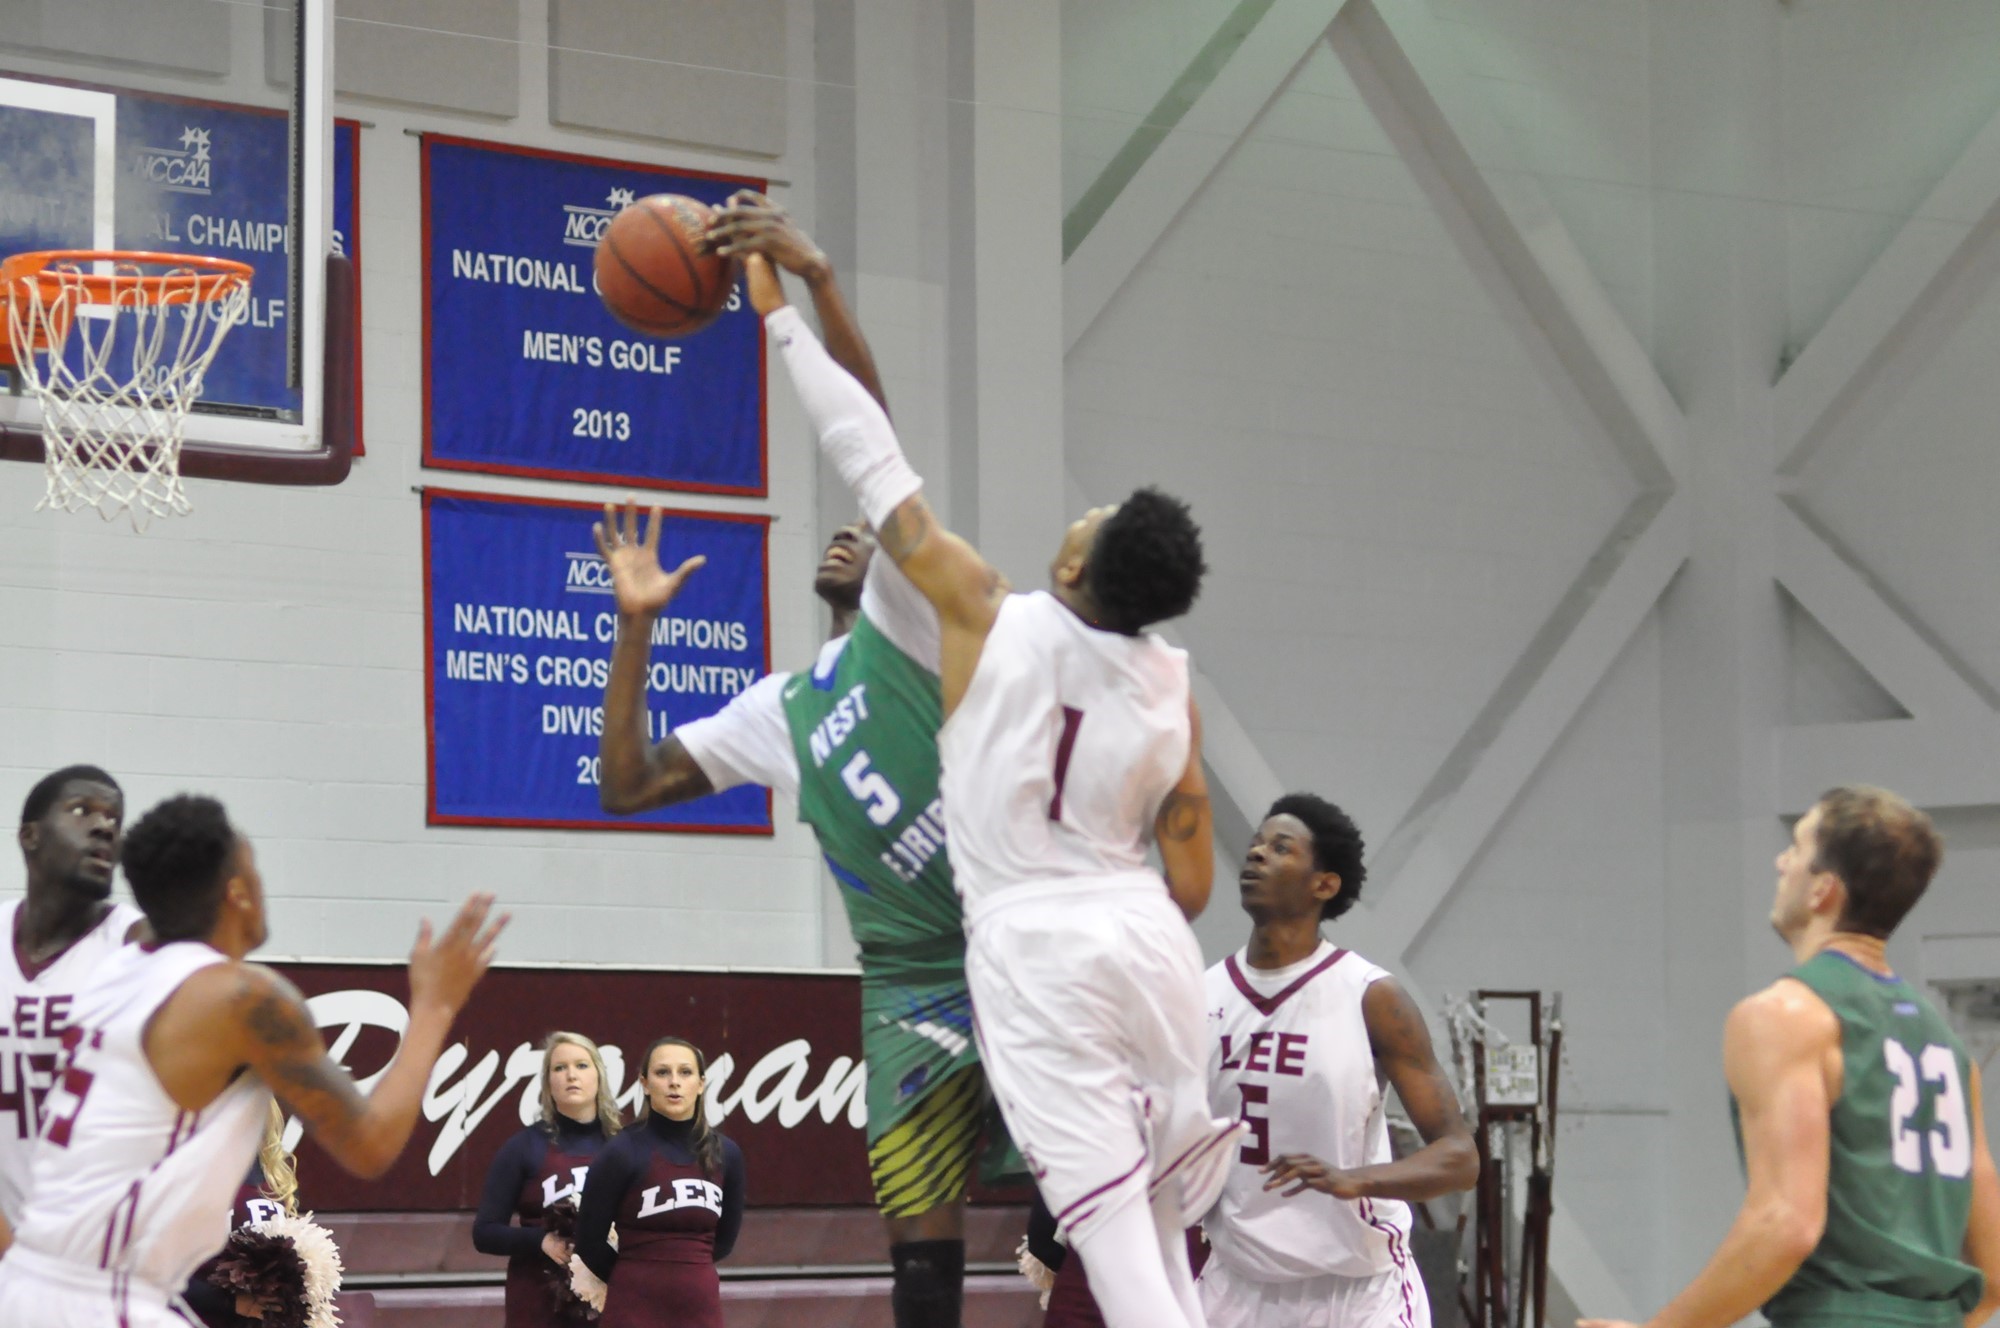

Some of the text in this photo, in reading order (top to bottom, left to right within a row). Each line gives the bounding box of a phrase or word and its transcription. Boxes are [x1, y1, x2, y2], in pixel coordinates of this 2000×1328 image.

[133, 156, 210, 188] NCCAA
[565, 212, 612, 241] NCC
[452, 249, 585, 293] NATIONAL
[523, 330, 681, 374] MEN'S GOLF
[573, 408, 631, 441] 2013
[566, 559, 614, 588] NCC
[454, 603, 589, 641] NATIONAL
[447, 650, 755, 695] MEN'S CROS OUNTRY
[1048, 704, 1084, 822] 1
[841, 750, 901, 826] 5
[1219, 1031, 1309, 1077] LEE
[1883, 1038, 1971, 1179] 23
[636, 1178, 724, 1219] LEE
